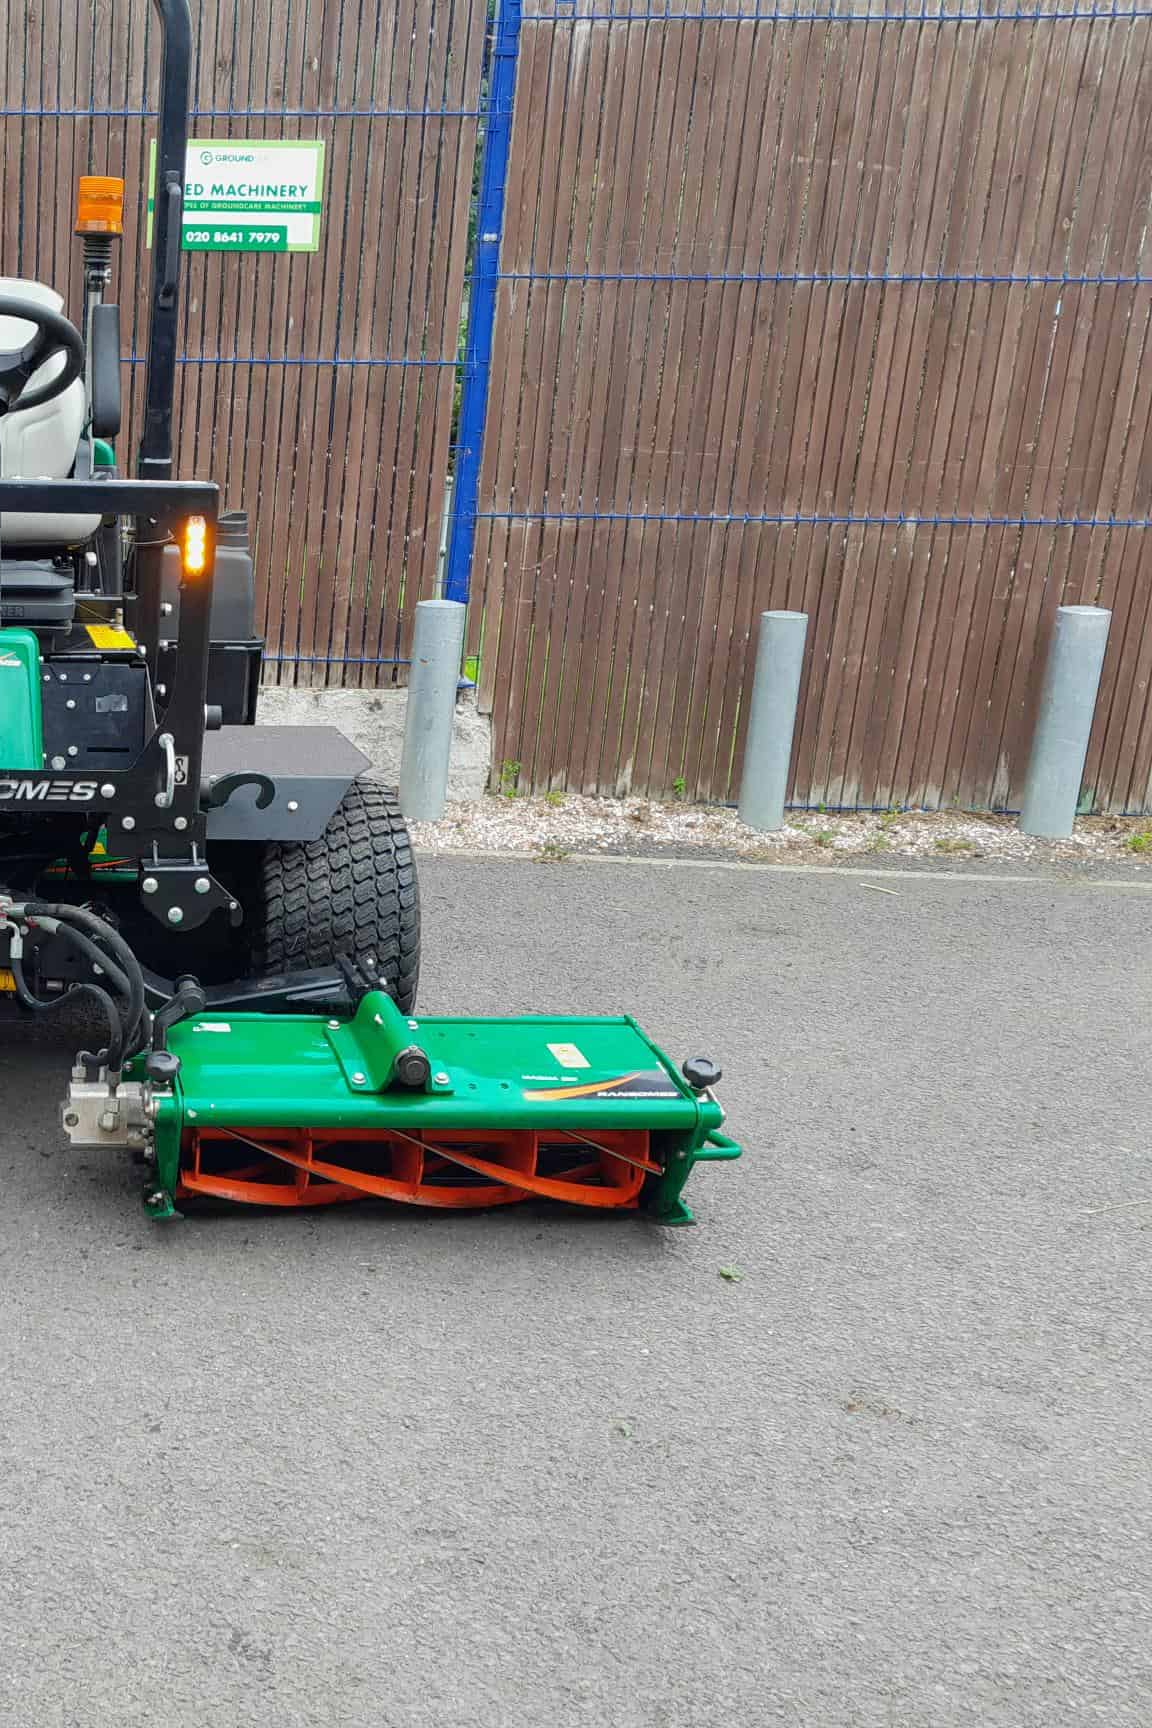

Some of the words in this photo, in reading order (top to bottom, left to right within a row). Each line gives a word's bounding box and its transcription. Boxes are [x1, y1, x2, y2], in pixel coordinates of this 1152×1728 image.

[215, 154, 255, 163] GROUND
[185, 183, 204, 196] ED
[210, 183, 309, 198] MACHINERY
[185, 231, 210, 243] 020
[213, 231, 243, 243] 8641
[249, 232, 280, 243] 7979
